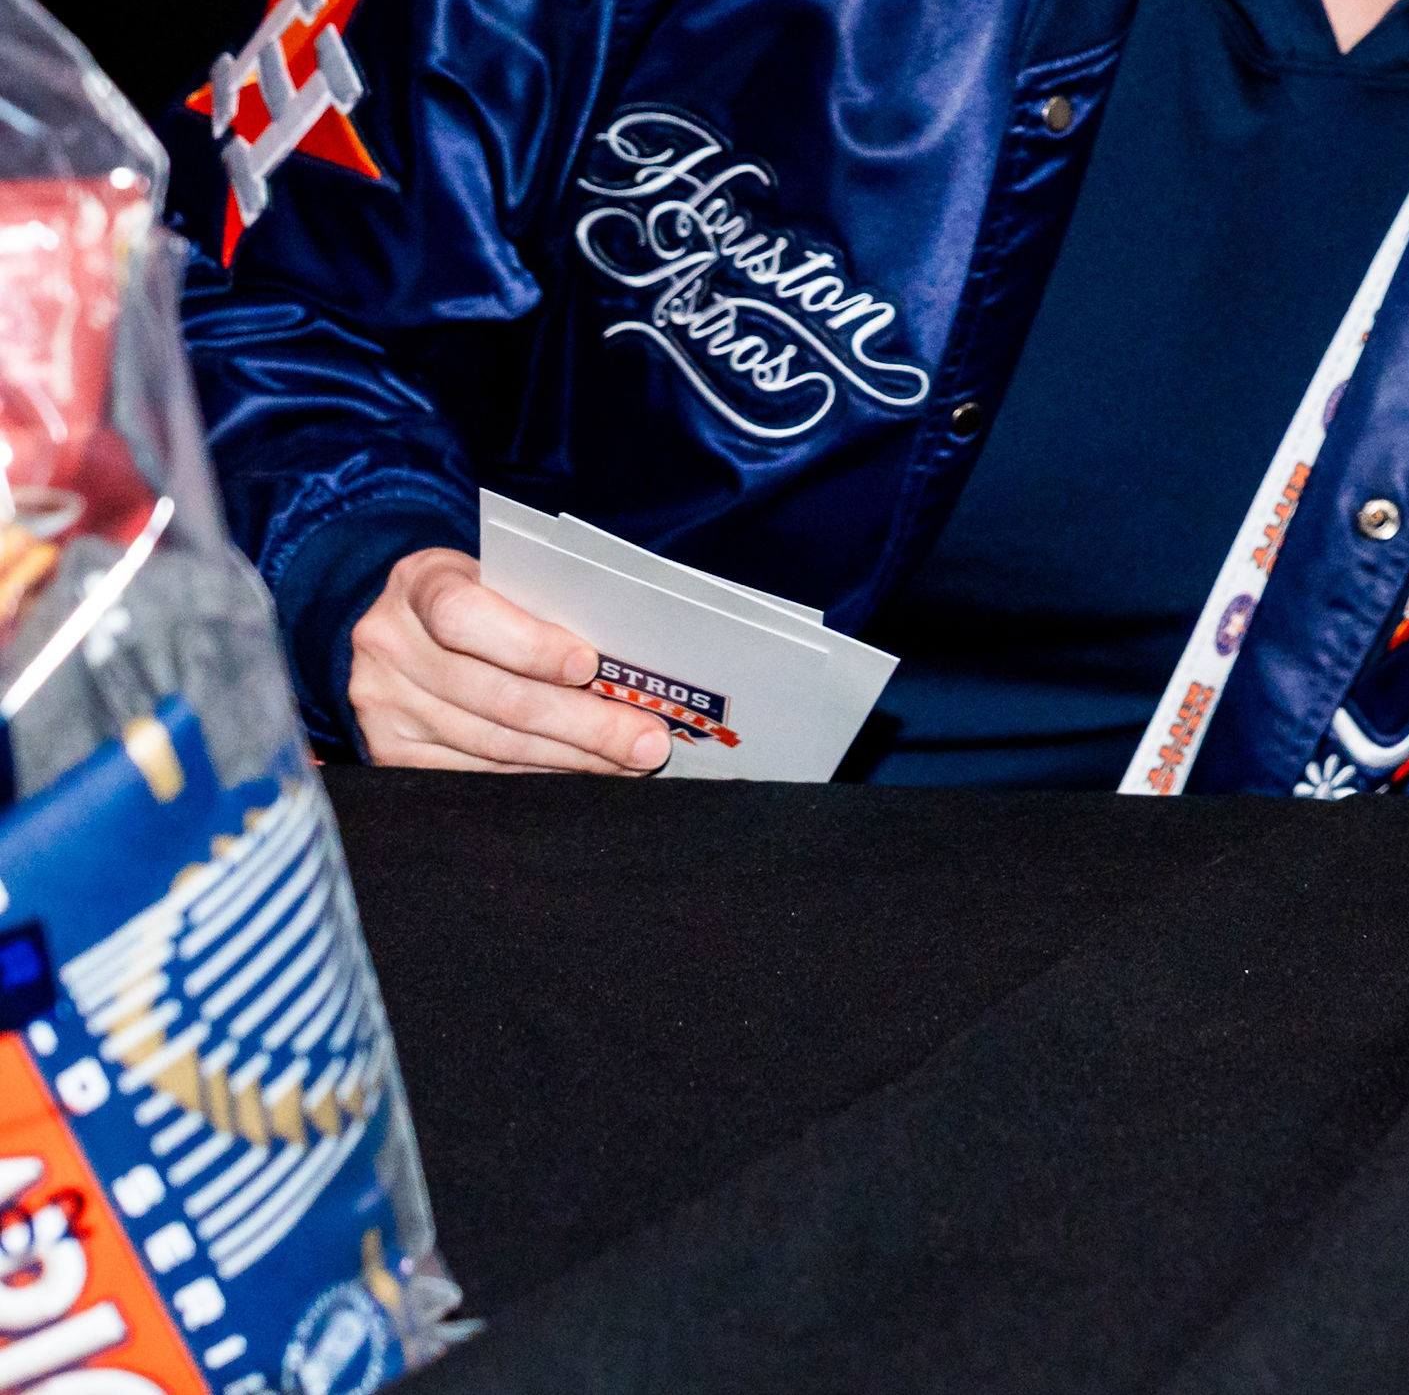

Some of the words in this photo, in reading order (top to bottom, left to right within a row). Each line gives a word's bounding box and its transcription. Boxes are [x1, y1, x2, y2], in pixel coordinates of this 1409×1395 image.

[575, 200, 836, 439] Astros
[577, 111, 930, 408] Houston
[591, 679, 720, 731] ANFEST
[600, 660, 712, 711] STROS
